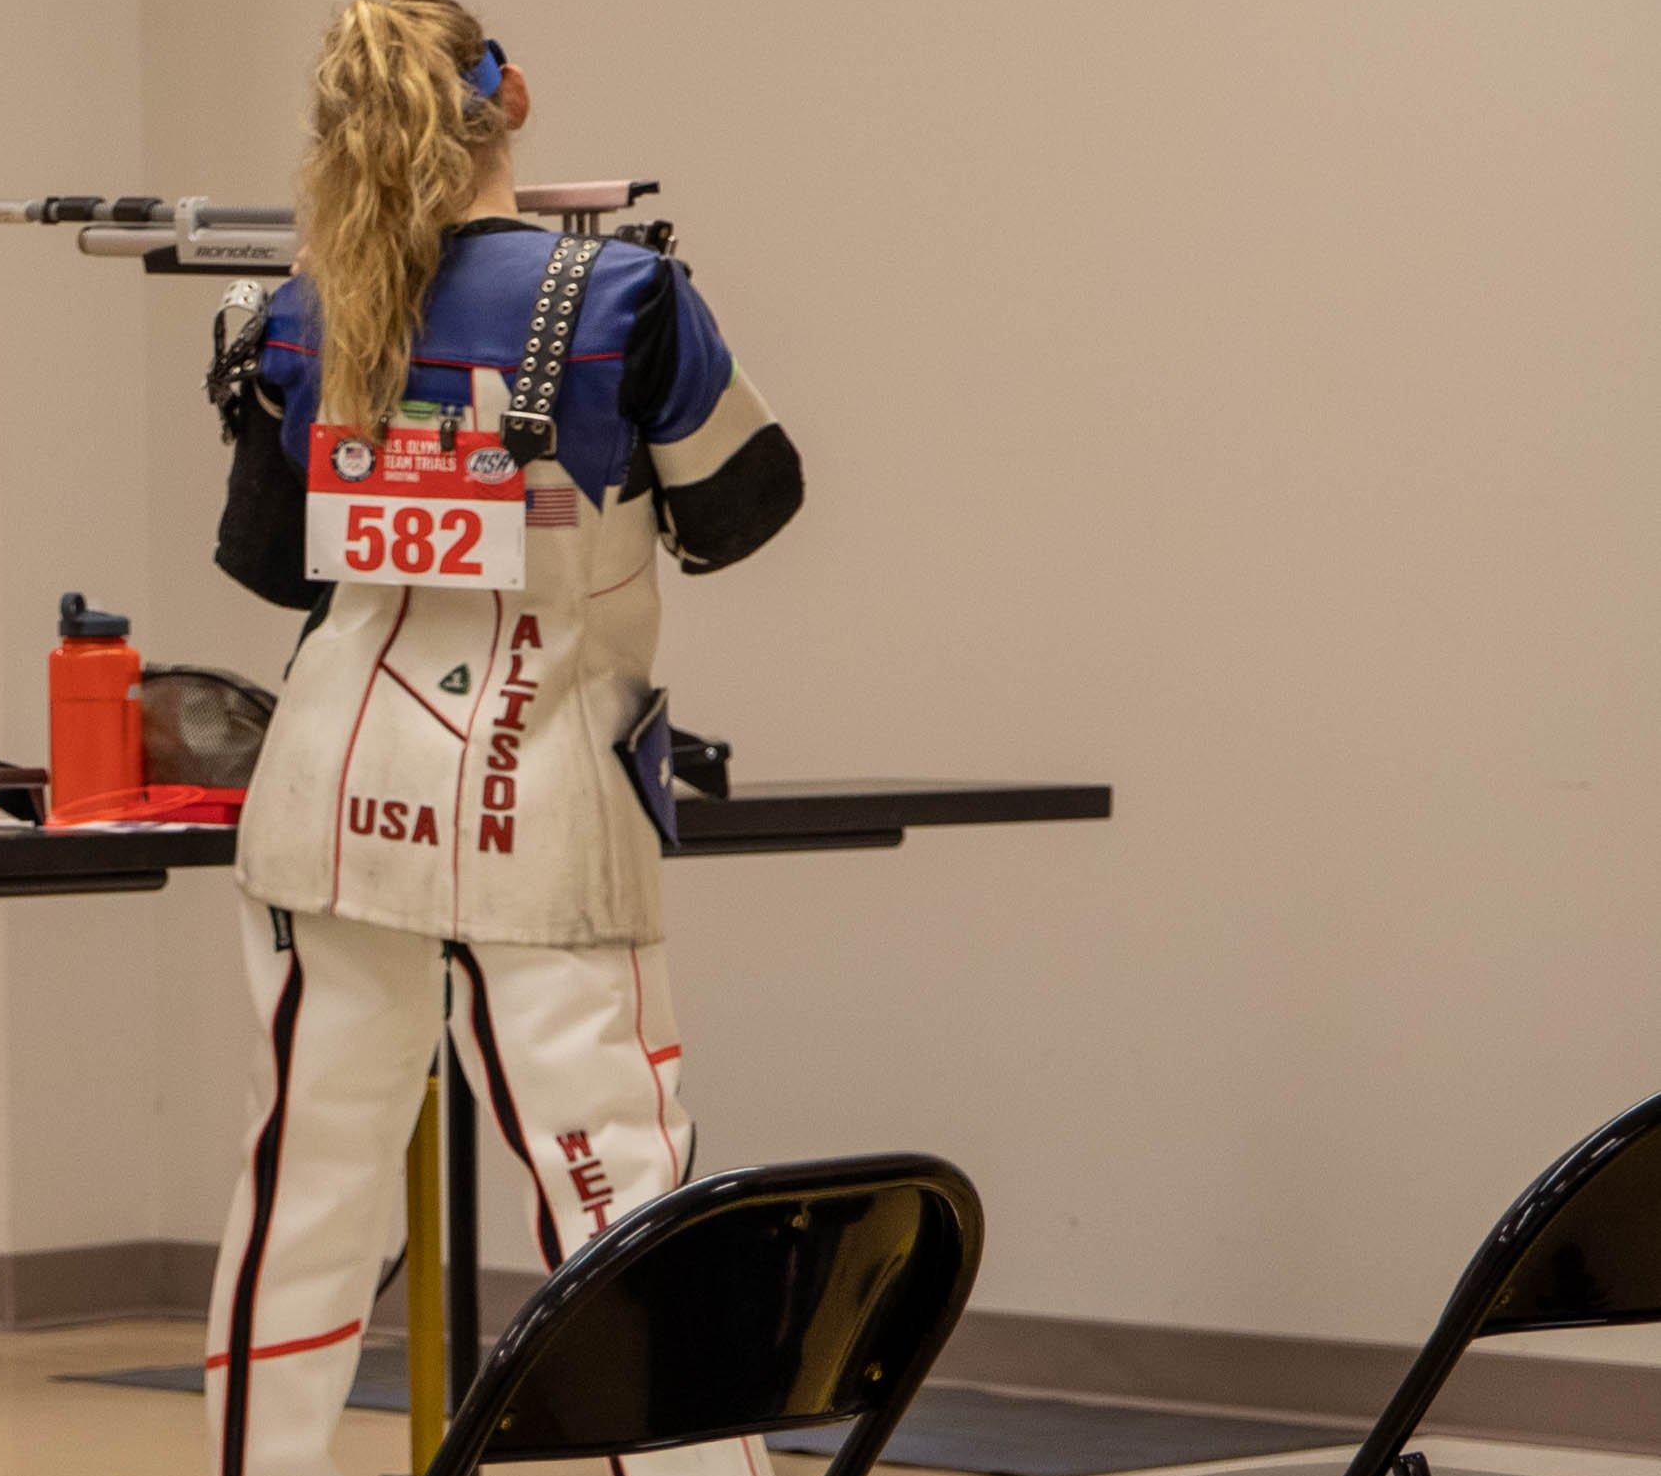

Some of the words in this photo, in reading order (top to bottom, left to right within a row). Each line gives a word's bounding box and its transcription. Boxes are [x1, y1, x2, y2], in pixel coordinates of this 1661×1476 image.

[345, 504, 484, 576] 582
[477, 613, 544, 855] ALISON
[347, 796, 440, 848] USA
